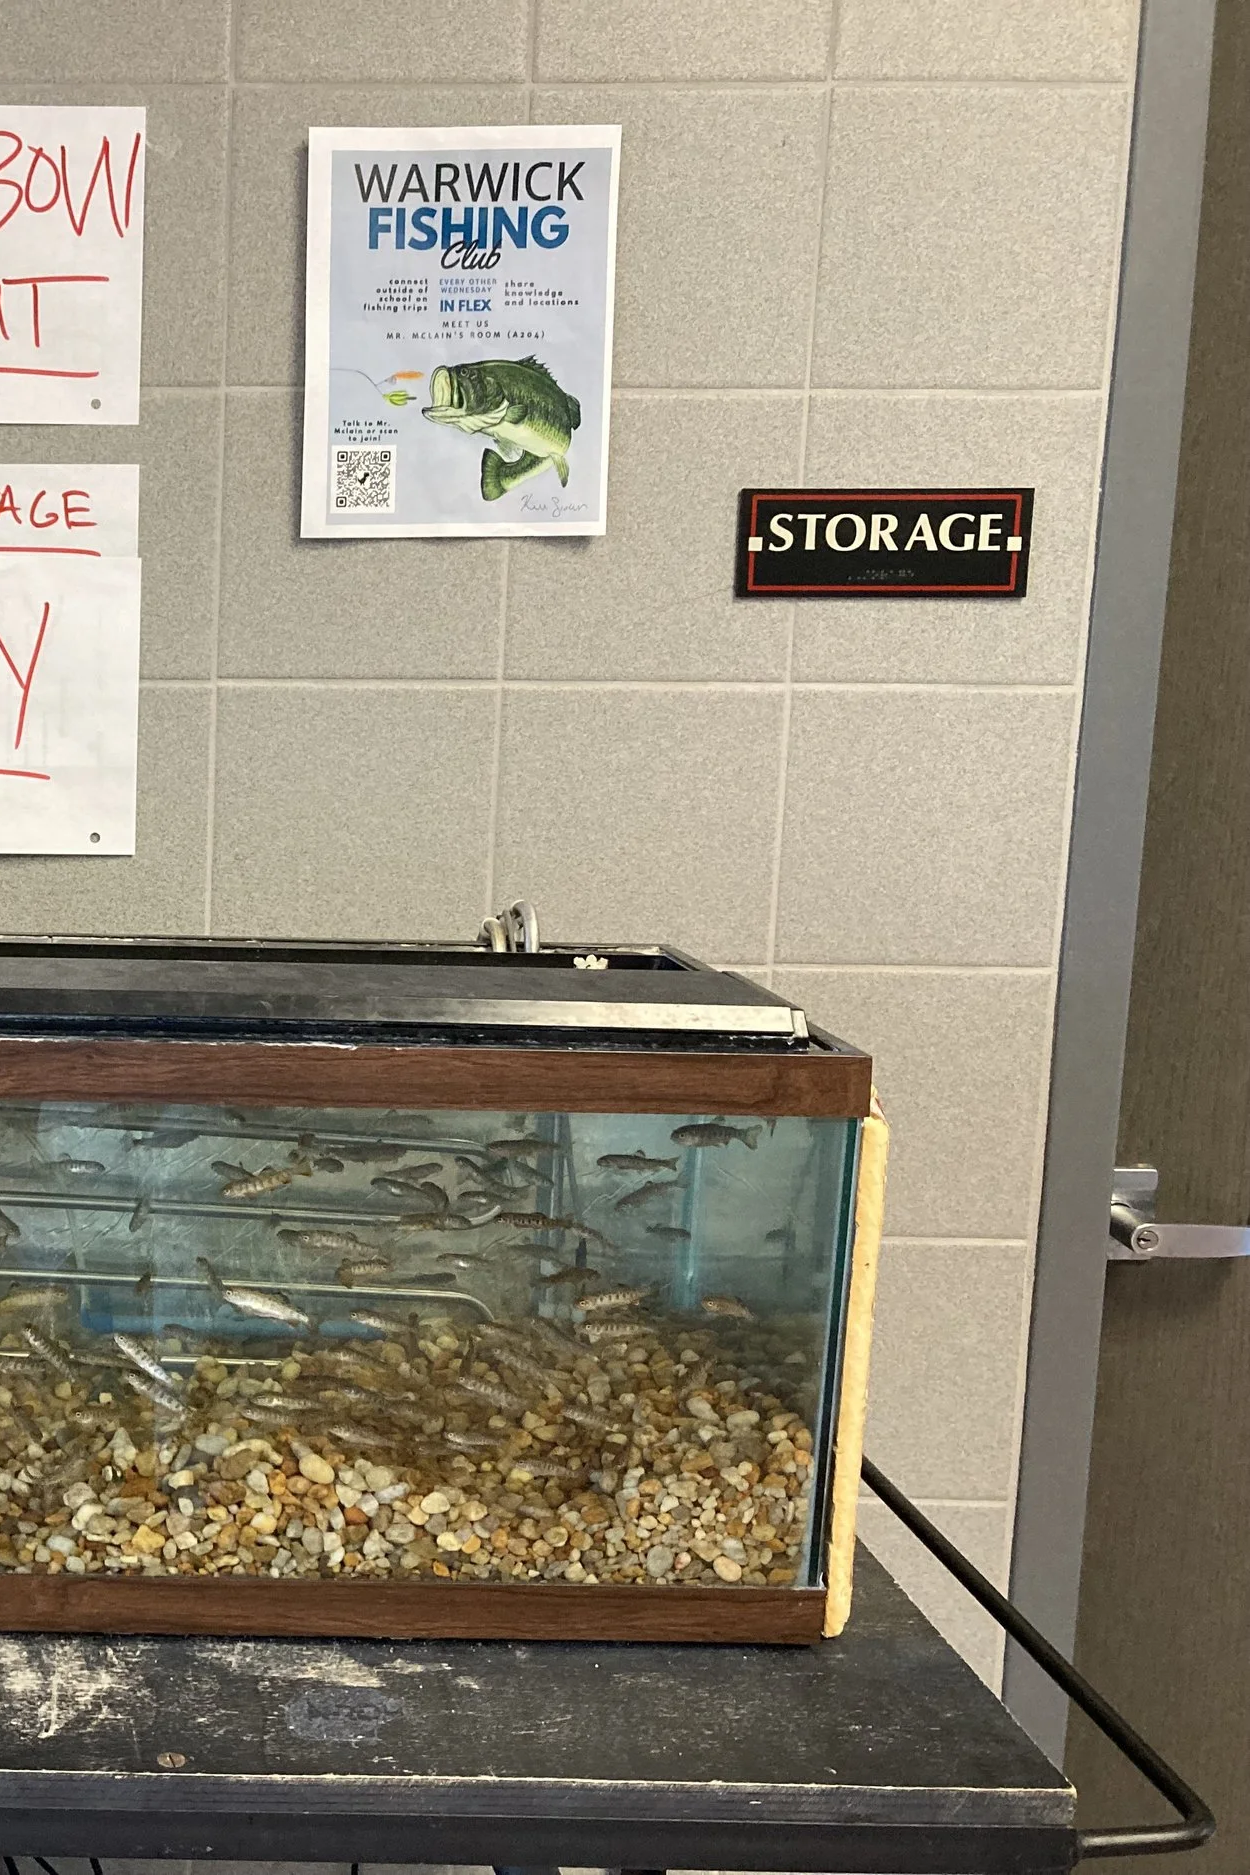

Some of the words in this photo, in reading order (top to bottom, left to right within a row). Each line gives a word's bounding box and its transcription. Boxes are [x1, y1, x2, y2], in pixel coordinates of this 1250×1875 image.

[354, 161, 586, 203] WARWICK
[368, 205, 570, 250] FISHING
[440, 239, 501, 270] Club
[504, 280, 535, 288] share
[376, 286, 413, 294] outside
[418, 286, 428, 294] of
[441, 286, 492, 294] WEDNESDAY
[504, 288, 563, 298] knowledge
[379, 294, 411, 302] school
[504, 298, 524, 306] and
[529, 298, 579, 306] locations
[363, 303, 398, 313] fishing
[403, 303, 428, 313] trips
[440, 299, 454, 312] IN
[458, 299, 492, 312] FLEX
[442, 320, 470, 328] MEET
[476, 320, 489, 328] US
[412, 331, 464, 339] MCLAIN'S
[507, 330, 545, 339] (A204)
[360, 435, 381, 443] join!
[768, 513, 1003, 551] STORAGE
